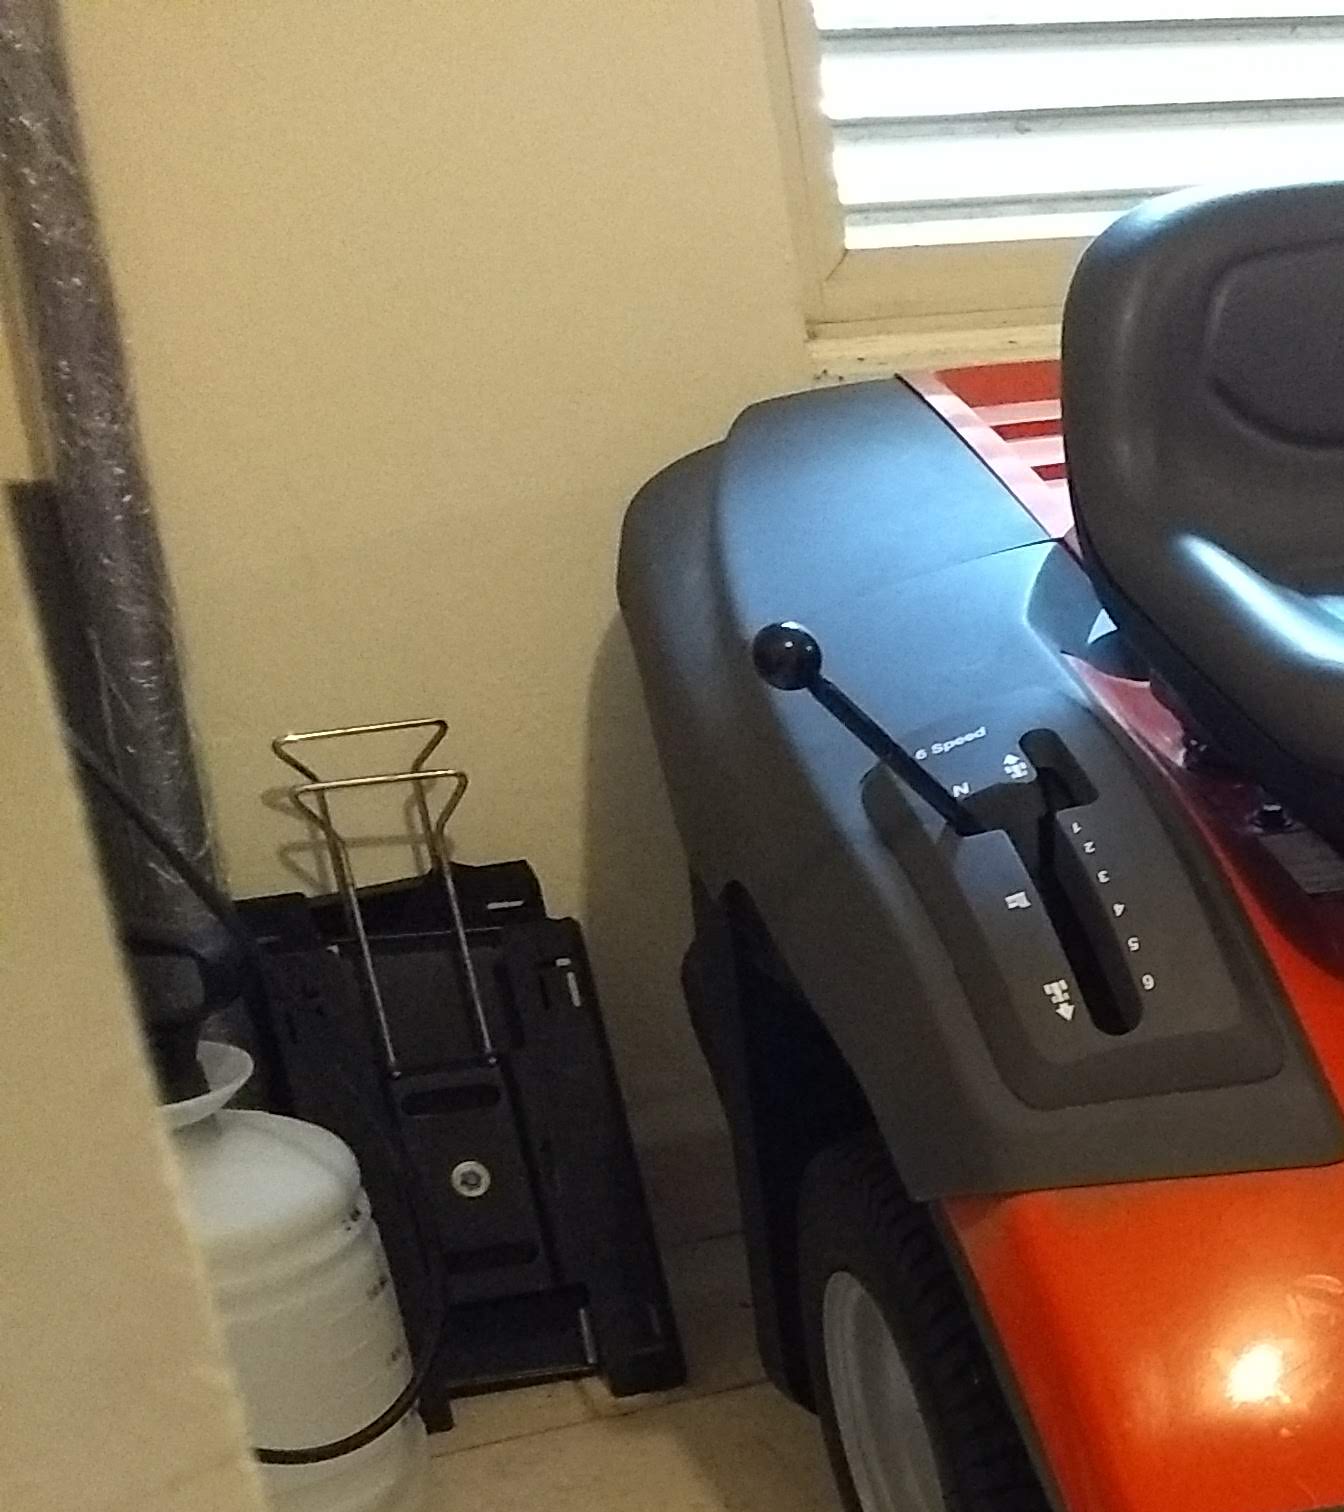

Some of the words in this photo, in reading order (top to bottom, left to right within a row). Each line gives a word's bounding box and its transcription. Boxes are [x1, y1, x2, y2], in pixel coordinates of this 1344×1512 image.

[915, 749, 928, 760] 6
[931, 726, 987, 755] Speed
[952, 781, 970, 798] N
[1127, 936, 1140, 951] 5
